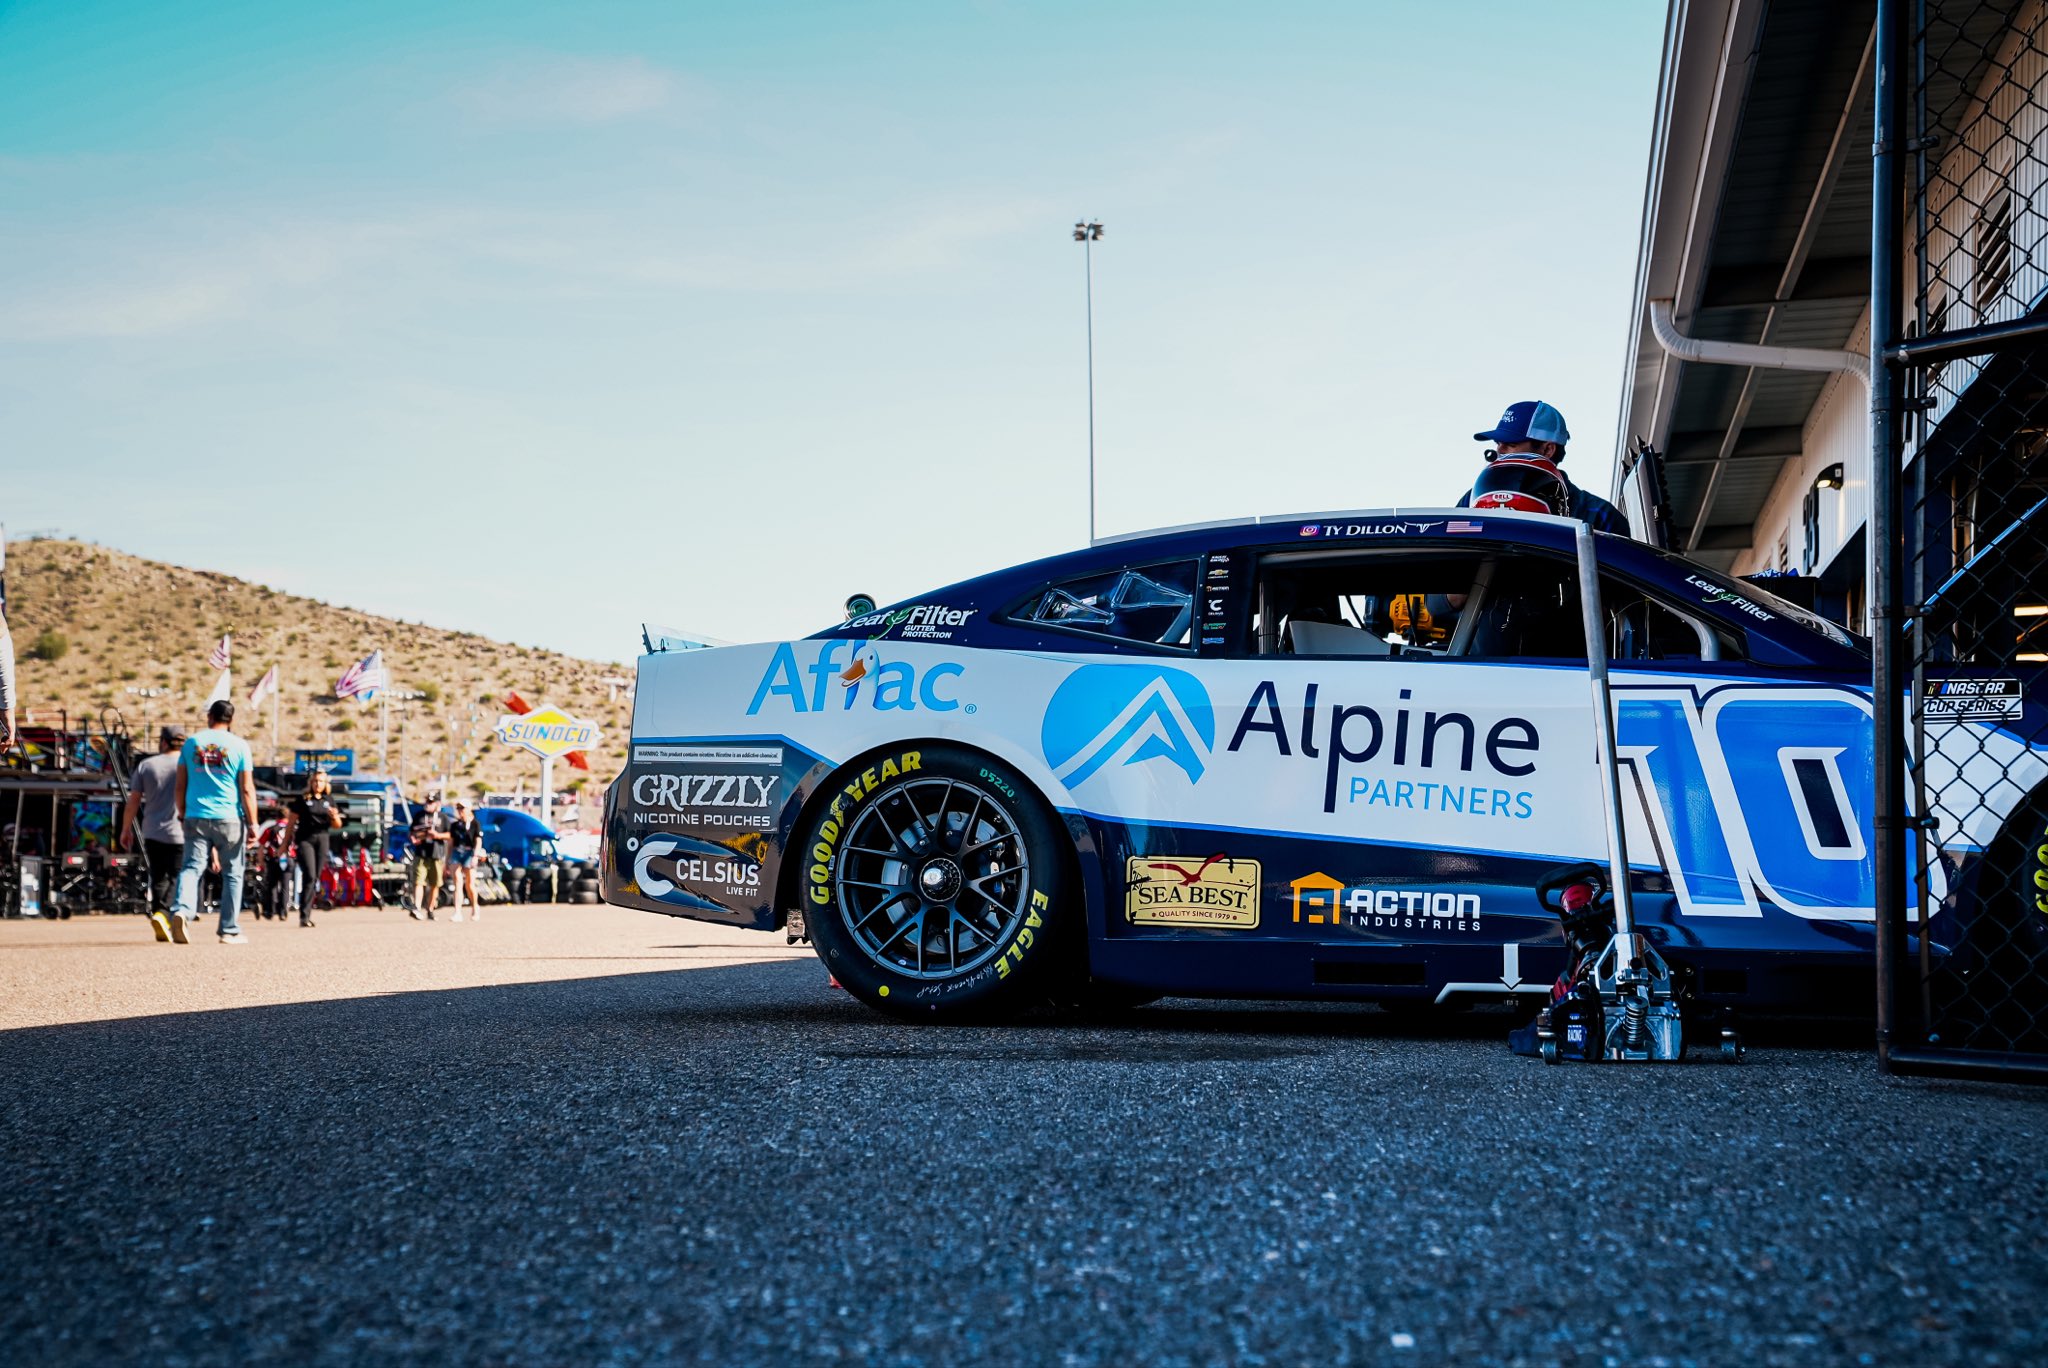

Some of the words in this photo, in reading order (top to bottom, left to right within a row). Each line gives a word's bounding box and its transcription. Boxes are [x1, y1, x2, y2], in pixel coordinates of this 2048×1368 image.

[1323, 525, 1343, 537] TY
[1345, 524, 1408, 536] DILLON
[901, 631, 952, 639] PROTECTION
[904, 624, 936, 632] GUTTER
[745, 639, 965, 716] Aflac
[1946, 682, 2006, 695] NASCAR
[1927, 700, 1955, 713] CUP
[1958, 699, 2007, 712] SERIES
[508, 723, 592, 743] SUNOCO
[1227, 680, 1540, 813] Alpine
[632, 773, 780, 812] GRIZZLY
[979, 767, 1015, 798] D5220
[1349, 776, 1533, 819] PARTNERS
[1597, 684, 1948, 921] 10
[633, 812, 699, 825] NICOTINE
[703, 814, 771, 827] POUCHES
[809, 750, 922, 905] GOODYEAR
[676, 858, 760, 886] CELSIUS
[726, 886, 743, 896] LIVE
[745, 887, 758, 897] FIT
[1138, 886, 1185, 905] SEA
[1188, 886, 1248, 909] BEST
[1349, 889, 1481, 918] ACTION
[1214, 912, 1231, 920] 1979
[1349, 917, 1481, 931] INDUSTRIES
[994, 889, 1049, 980] EAGLE
